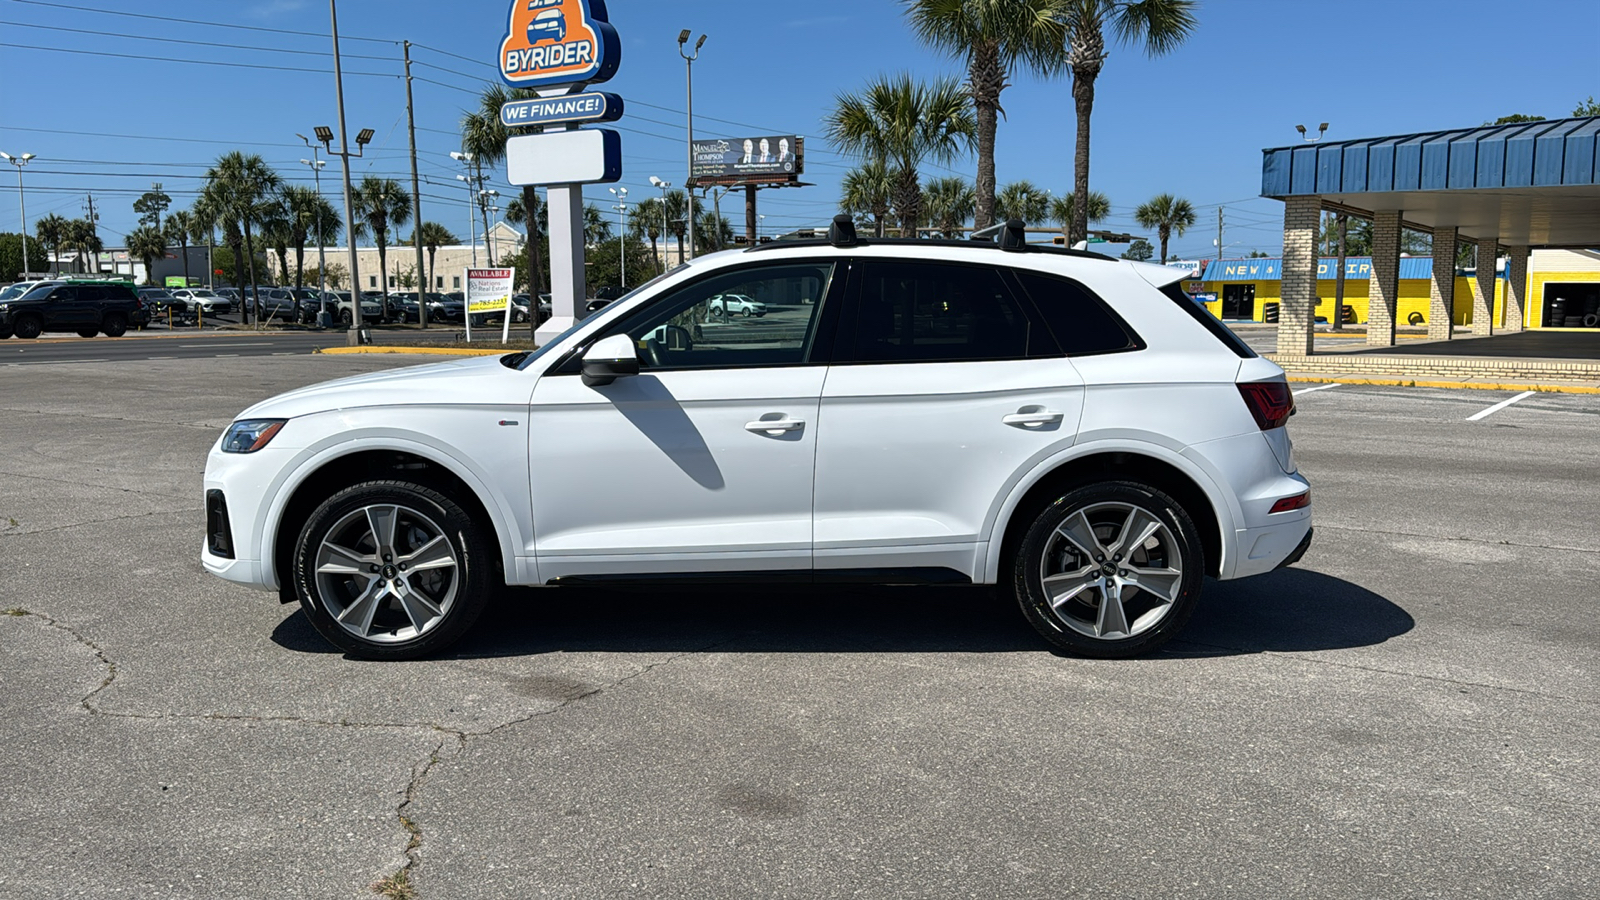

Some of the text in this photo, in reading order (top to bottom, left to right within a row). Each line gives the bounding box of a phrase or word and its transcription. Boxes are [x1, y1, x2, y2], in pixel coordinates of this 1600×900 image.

[506, 41, 591, 72] BYRIDER
[506, 99, 599, 119] WE FINANCE!
[692, 152, 724, 161] THOMPSON
[470, 270, 509, 278] AVAILABLE
[1226, 265, 1259, 275] NEW
